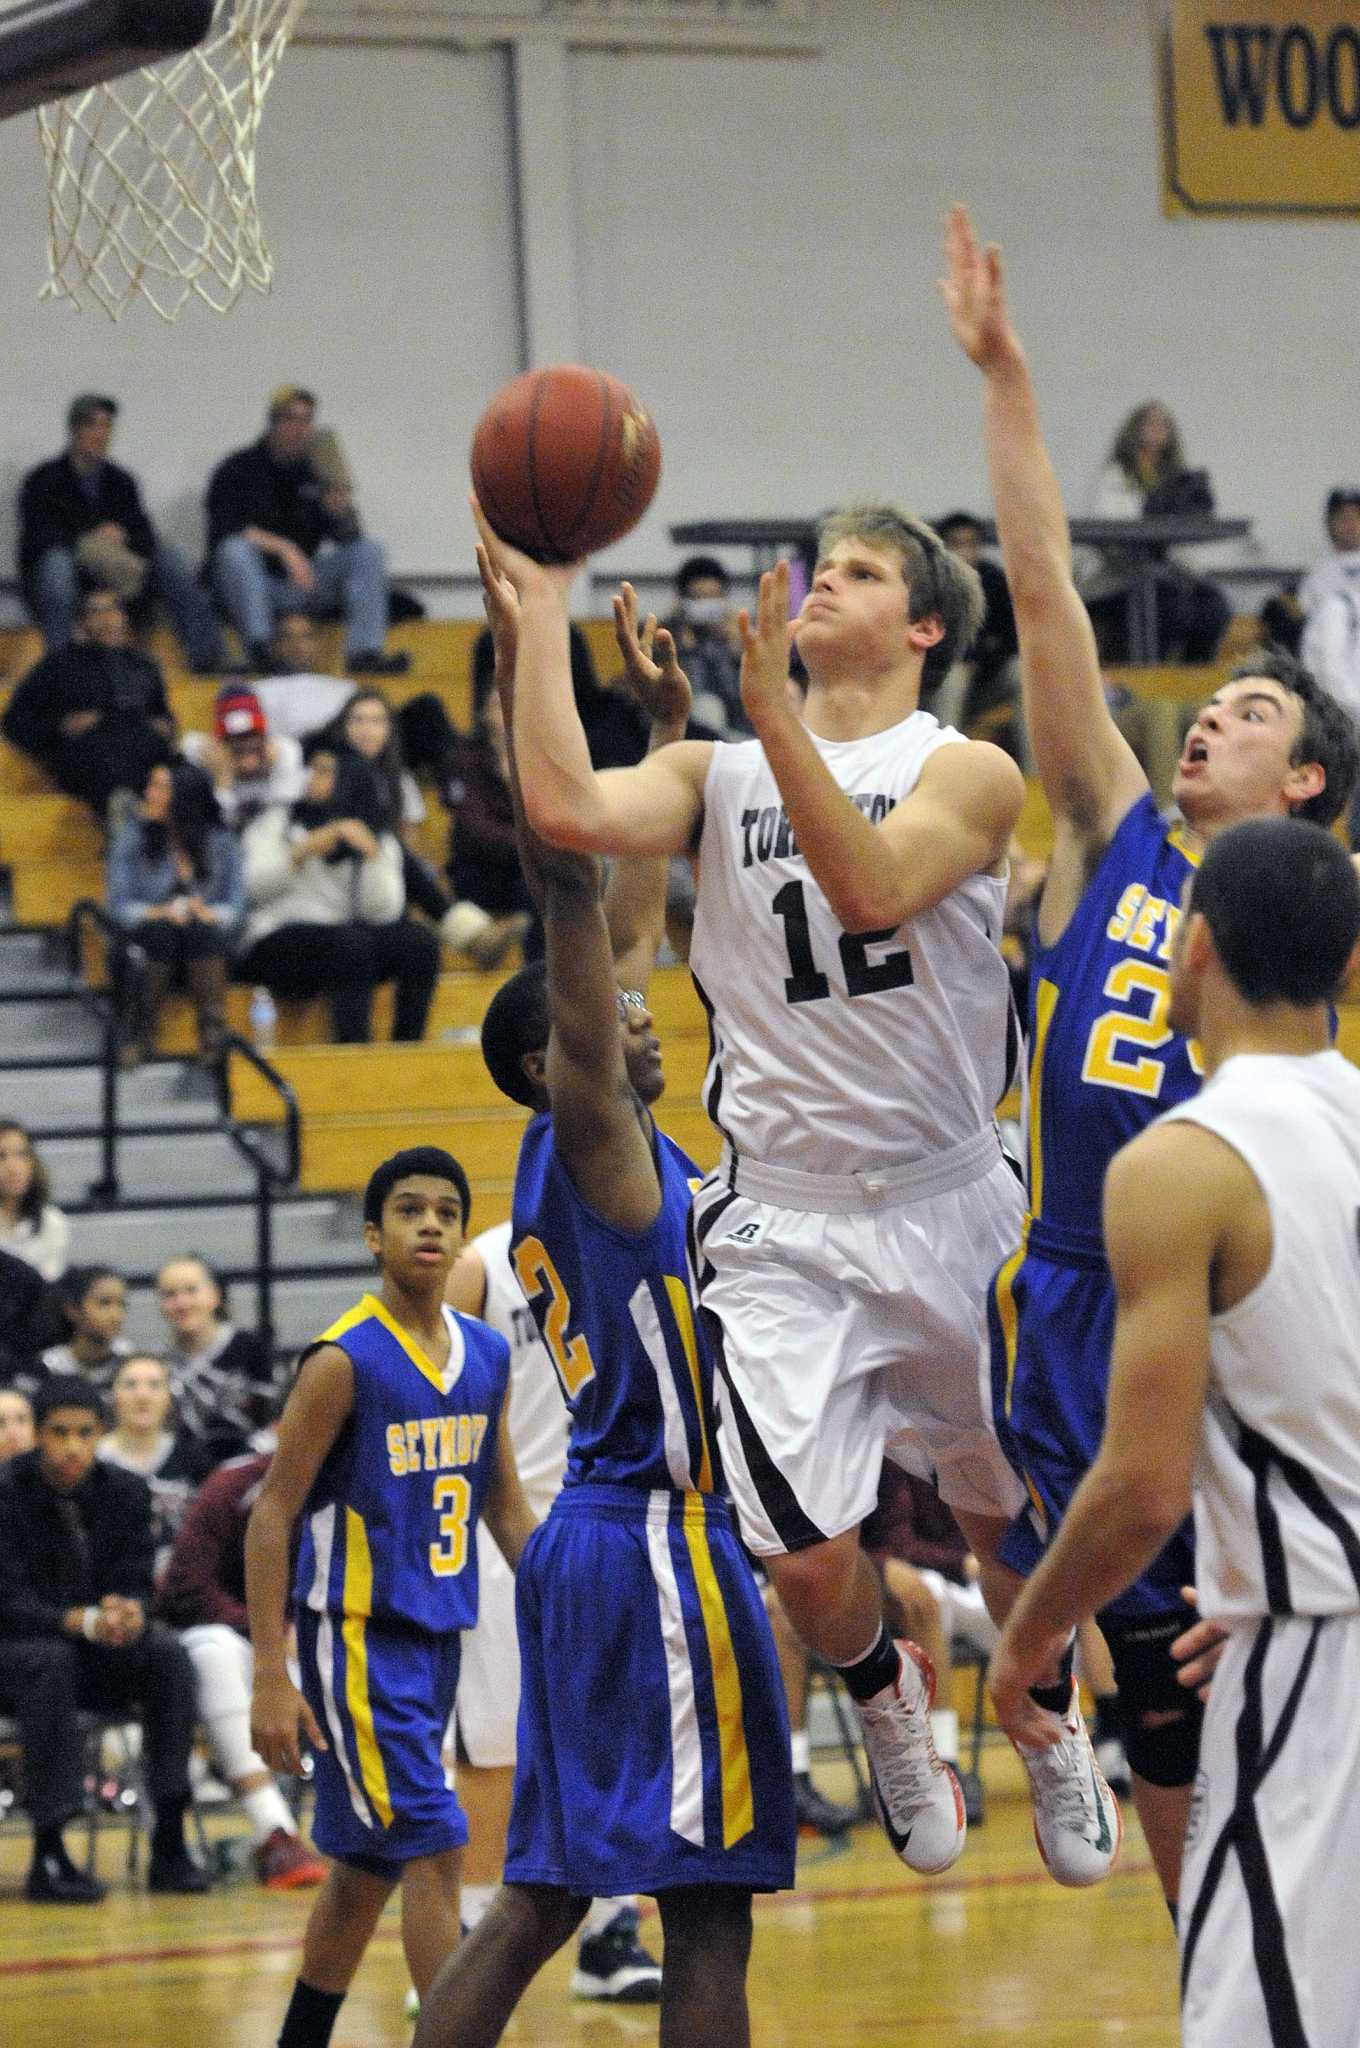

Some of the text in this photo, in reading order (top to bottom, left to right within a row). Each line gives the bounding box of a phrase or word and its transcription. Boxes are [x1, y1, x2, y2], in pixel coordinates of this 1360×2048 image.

[772, 879, 914, 1003] 12
[1081, 957, 1208, 1098] 2
[429, 1474, 471, 1577] 3
